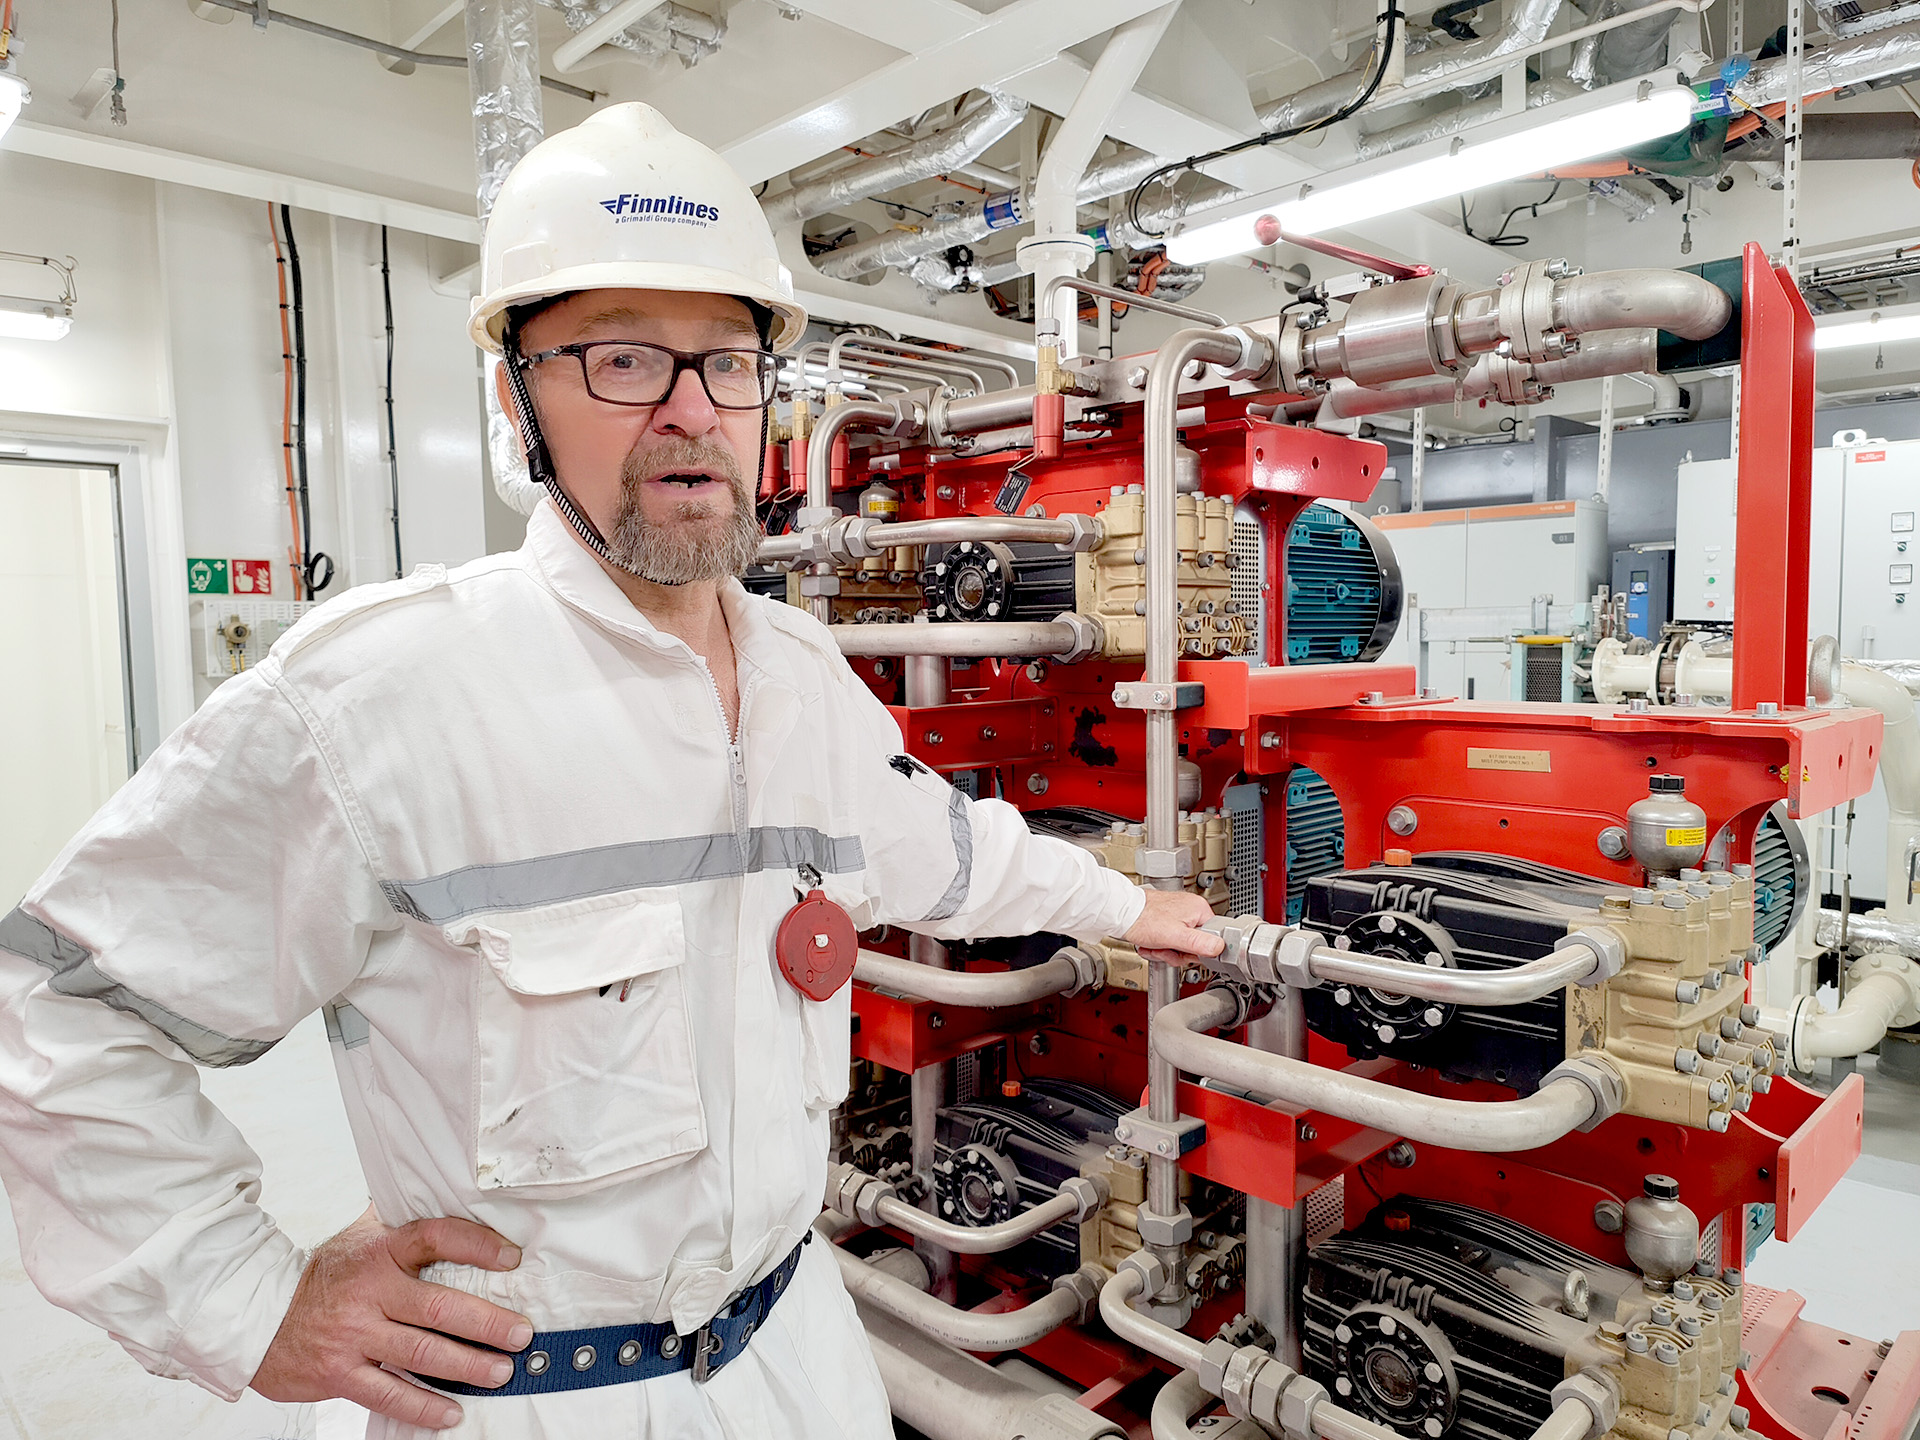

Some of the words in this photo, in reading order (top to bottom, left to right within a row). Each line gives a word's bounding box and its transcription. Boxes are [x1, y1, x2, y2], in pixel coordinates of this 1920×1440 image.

[616, 193, 719, 222] Finnlines
[621, 215, 653, 223] Grimaldi
[655, 214, 676, 223] Group
[677, 217, 707, 228] company
